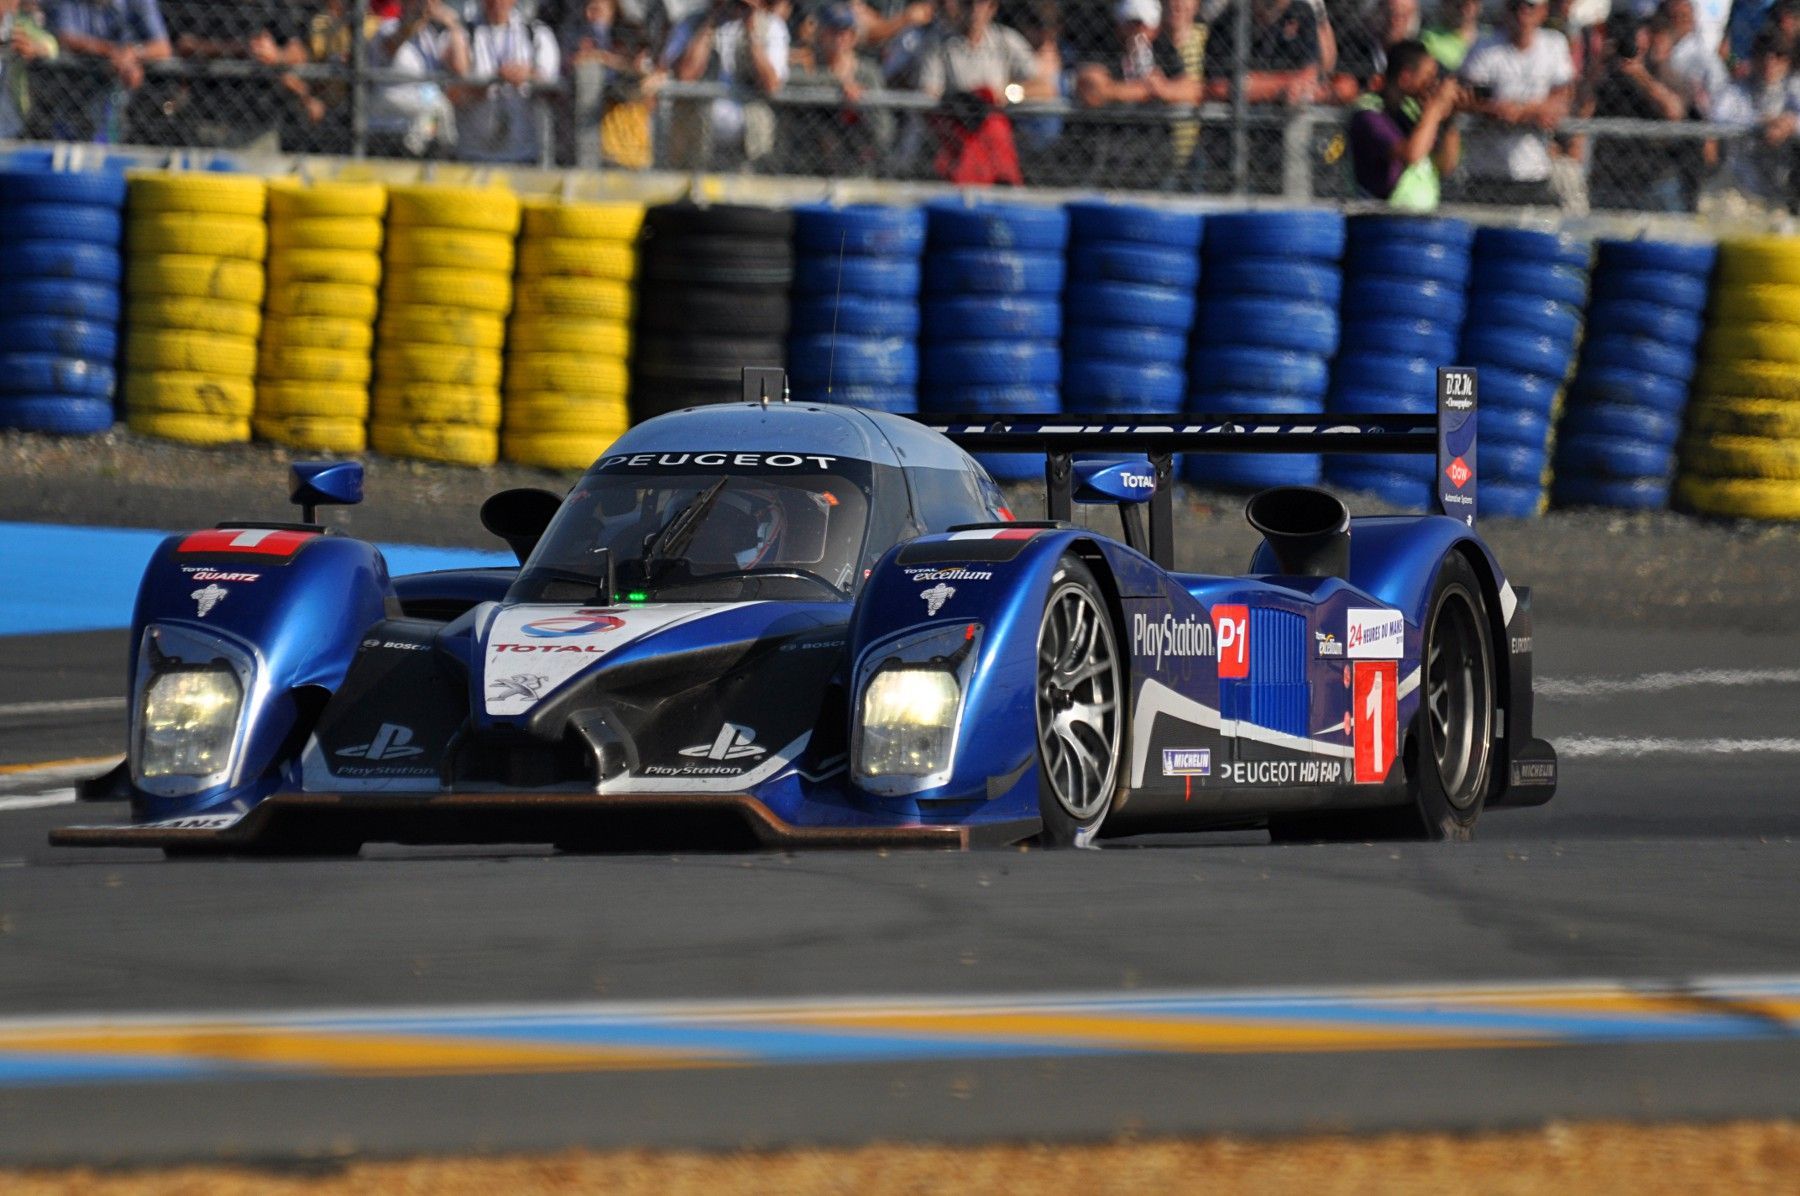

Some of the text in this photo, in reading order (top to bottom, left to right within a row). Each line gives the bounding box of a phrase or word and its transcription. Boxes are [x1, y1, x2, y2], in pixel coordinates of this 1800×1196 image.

[599, 453, 839, 470] PEUGEOT
[192, 571, 261, 582] QUARTZ
[912, 568, 994, 582] excellium
[1217, 617, 1246, 664] P1
[1349, 624, 1362, 648] 24
[1363, 626, 1381, 644] HEURES
[1381, 623, 1389, 638] DU
[1389, 619, 1403, 636] MANS
[1133, 613, 1213, 671] PlayStation
[1366, 670, 1383, 773] 1
[1174, 753, 1209, 768] MICHELIN
[336, 766, 434, 777] PlayStation
[644, 766, 743, 776] PlayStation
[1220, 762, 1298, 783] PEUGEOT
[1320, 761, 1341, 783] FAP
[1521, 764, 1554, 778] MICHELIN
